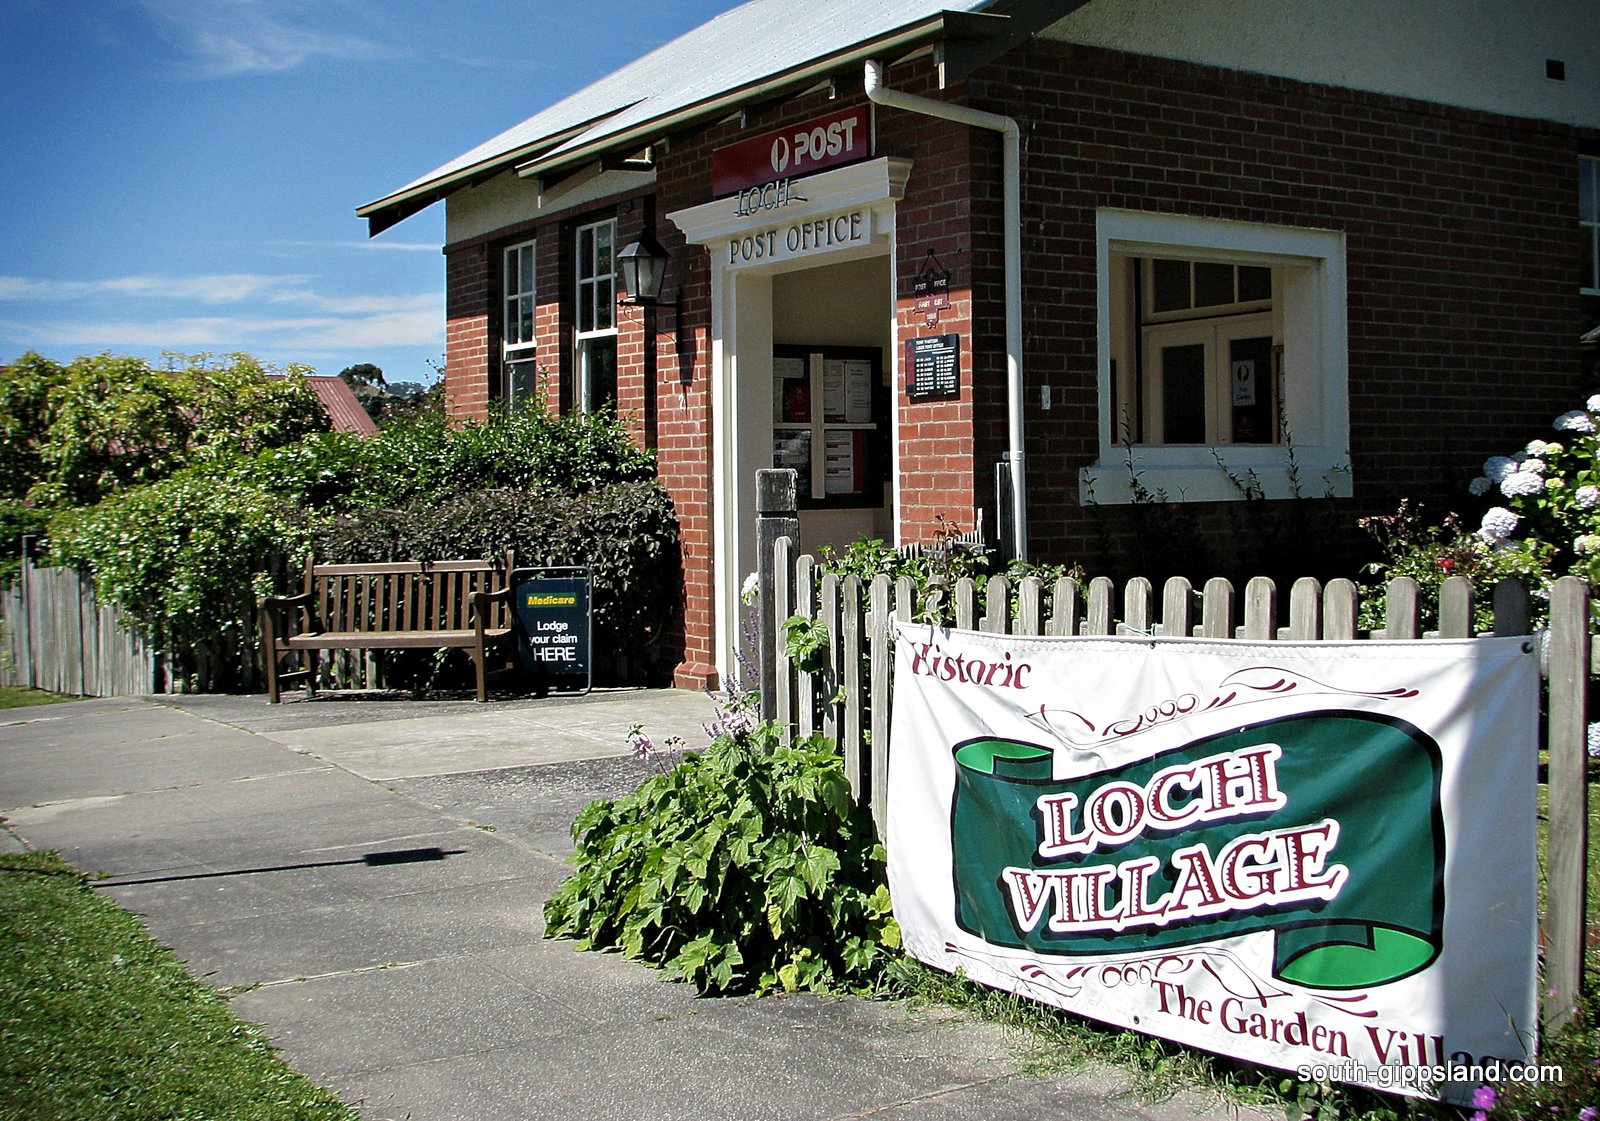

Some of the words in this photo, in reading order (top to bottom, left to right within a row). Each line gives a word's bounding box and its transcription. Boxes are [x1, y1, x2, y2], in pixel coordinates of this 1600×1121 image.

[795, 117, 857, 166] POST
[734, 178, 792, 217] LOCH
[729, 230, 777, 264] POST
[786, 212, 862, 252] OFFICE
[527, 595, 576, 606] Medicare
[528, 636, 551, 646] your
[552, 634, 578, 644] claim
[536, 620, 569, 633] Lodge
[533, 647, 577, 661] HERE
[910, 641, 1032, 690] Historic
[1037, 743, 1287, 858] LOCH
[1002, 818, 1349, 931] VILLAGE
[1150, 980, 1213, 1025] The
[1219, 998, 1353, 1059] Garden
